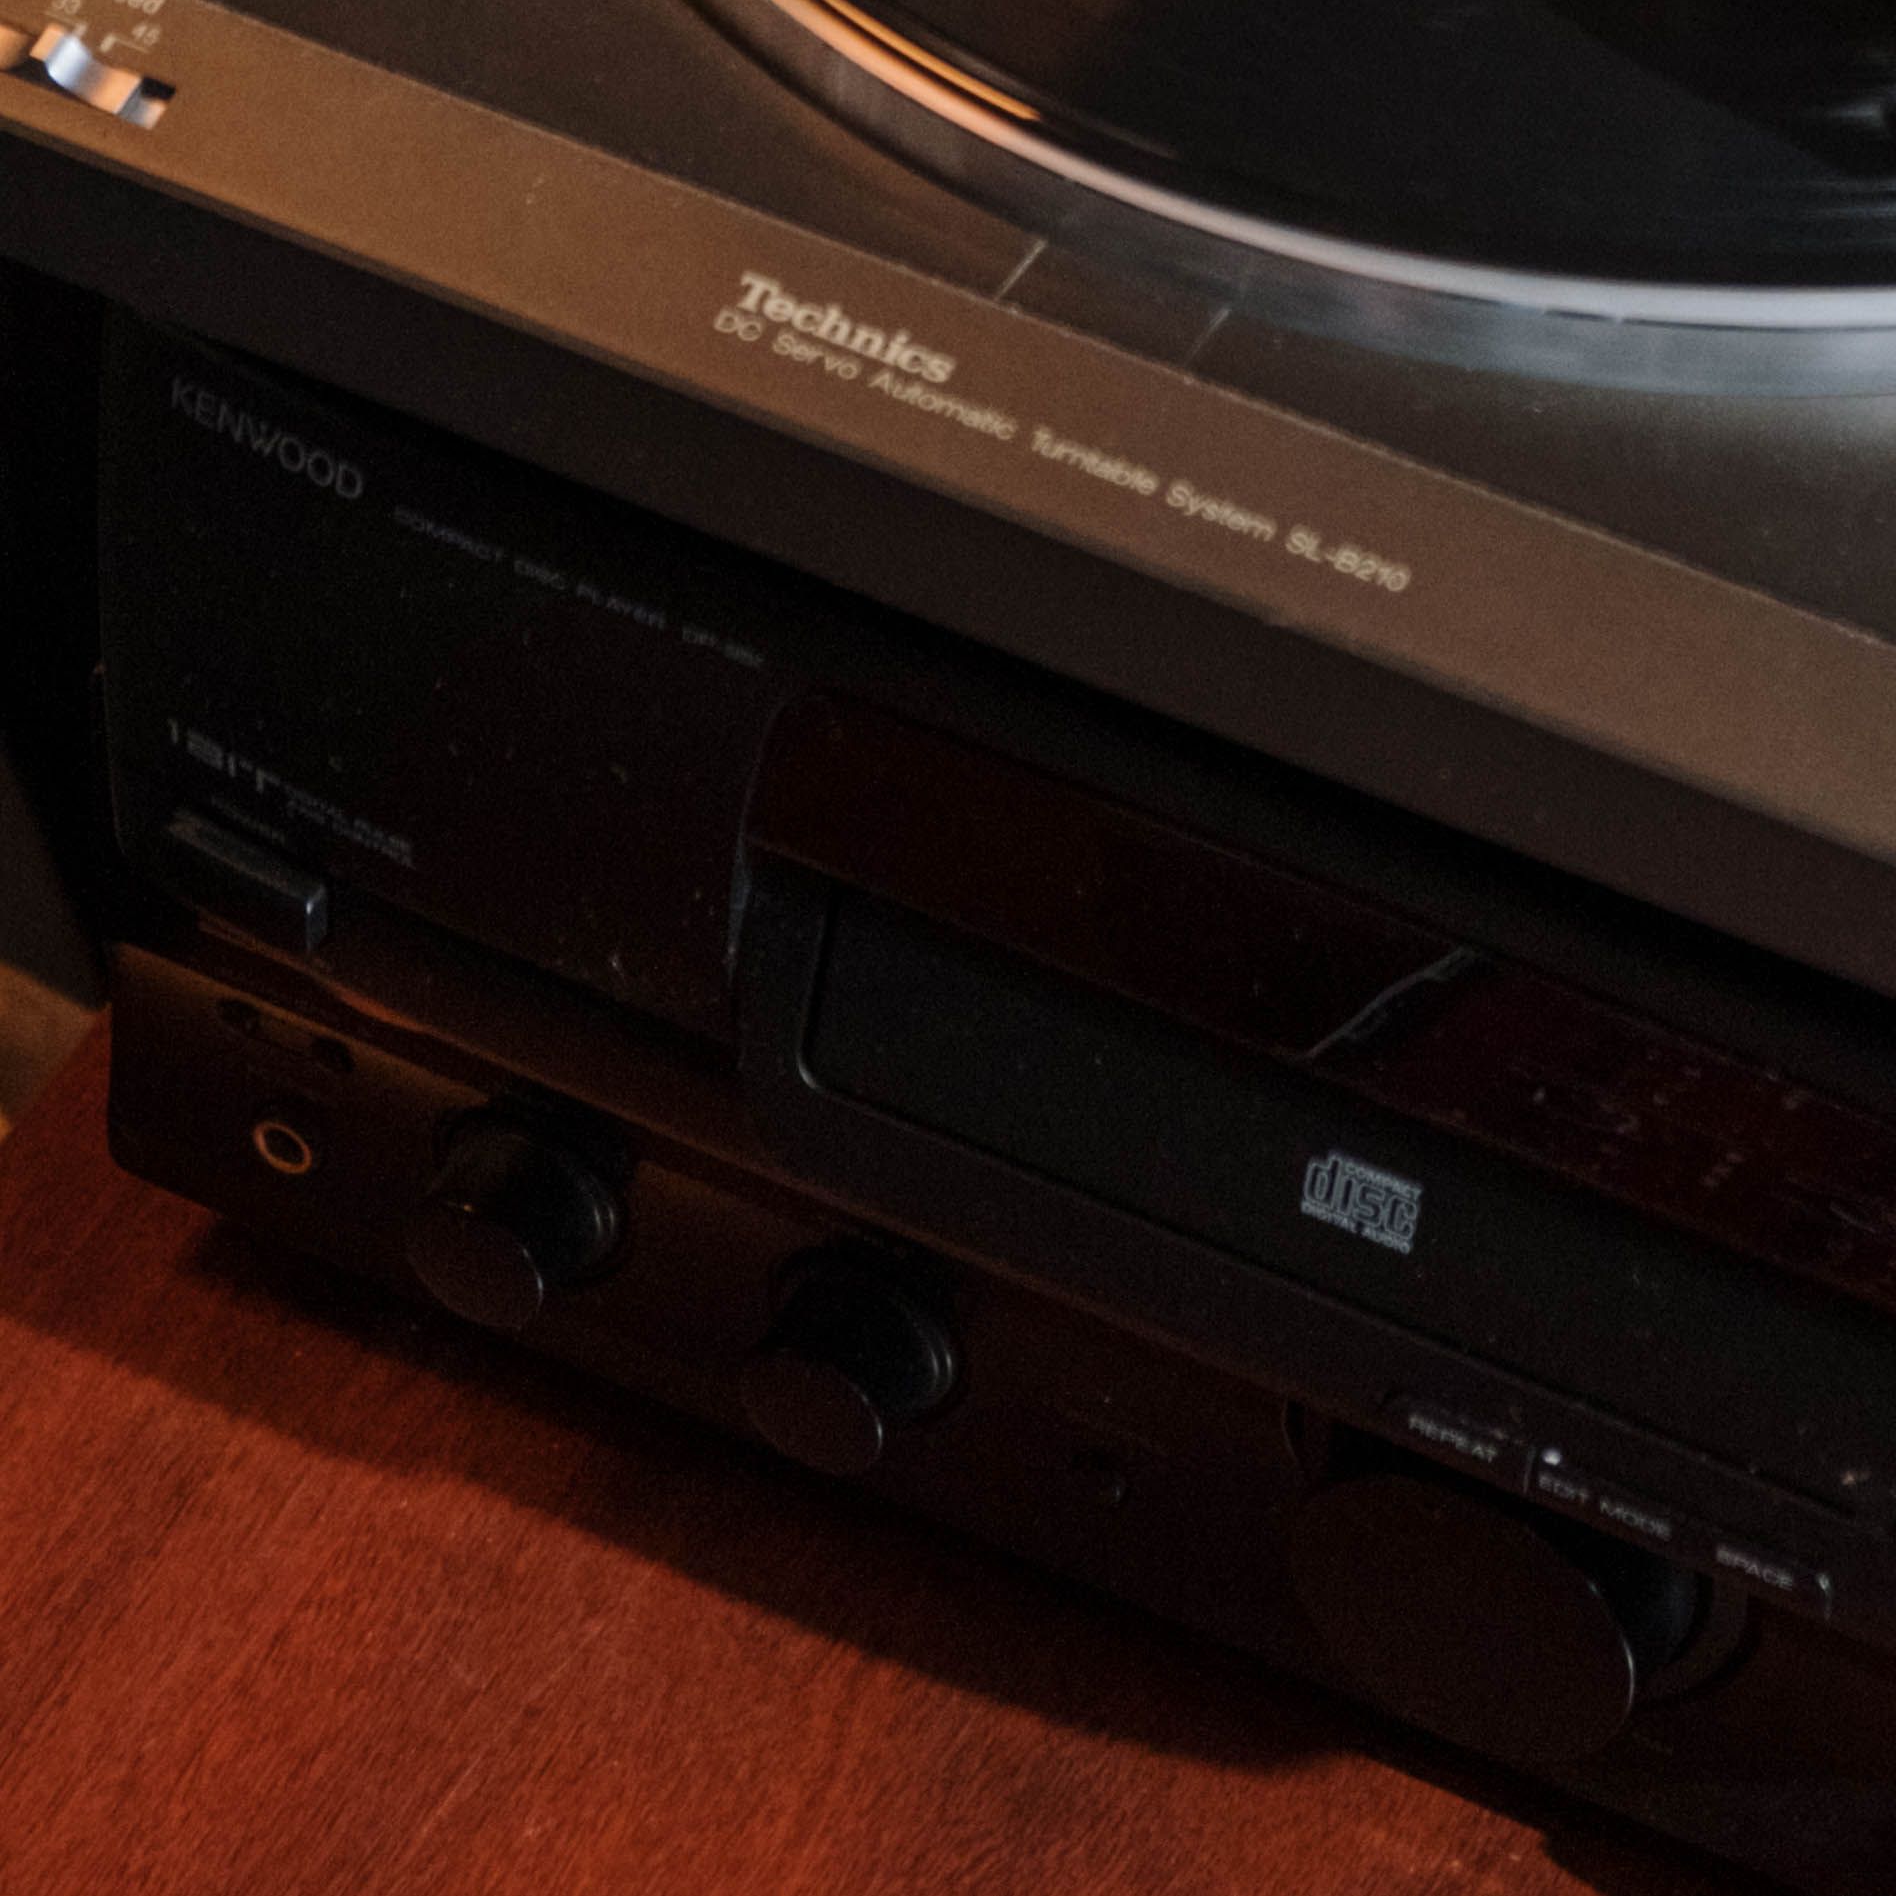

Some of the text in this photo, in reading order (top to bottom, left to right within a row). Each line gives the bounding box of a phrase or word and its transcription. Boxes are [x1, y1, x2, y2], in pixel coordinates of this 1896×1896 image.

[738, 273, 953, 382] Technics
[172, 378, 363, 499] KENWOOD
[714, 309, 1410, 591] DC Servo Automatic Turntable System SL-B210
